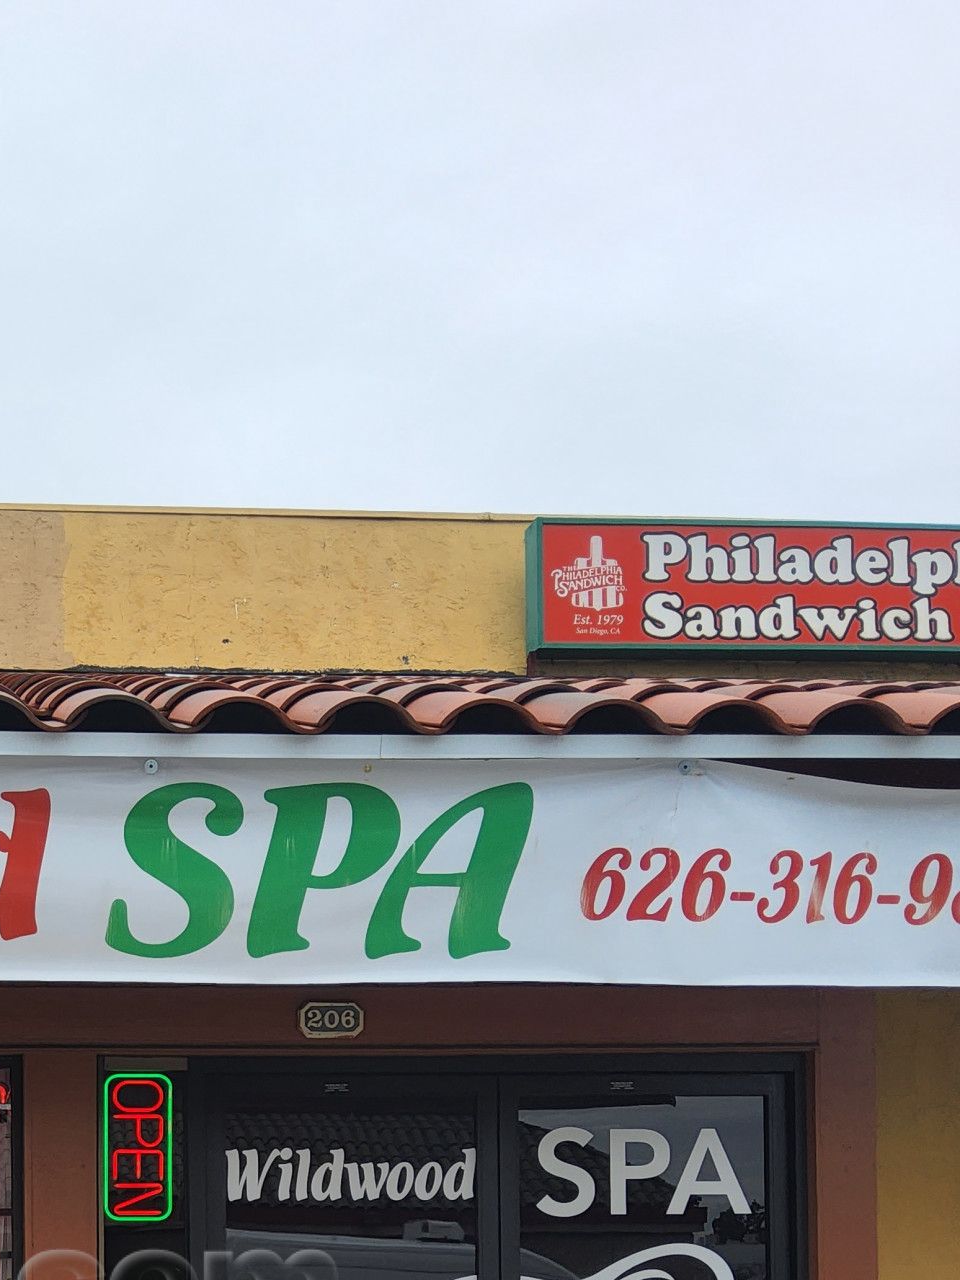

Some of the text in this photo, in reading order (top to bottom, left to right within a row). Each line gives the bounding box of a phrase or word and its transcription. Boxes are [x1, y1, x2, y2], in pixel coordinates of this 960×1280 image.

[551, 566, 622, 590] PHILADELPHIA
[557, 575, 622, 597] SANDWICH
[641, 532, 960, 596] Philadelp
[573, 614, 624, 626] Est. 1979
[642, 592, 954, 642] Sandwich
[104, 781, 534, 960] SPA
[580, 846, 960, 926] 626-316-9
[307, 1009, 356, 1029] 206
[111, 1079, 165, 1217] OPEN
[536, 1126, 752, 1218] SPA
[225, 1147, 477, 1202] Wildwood
